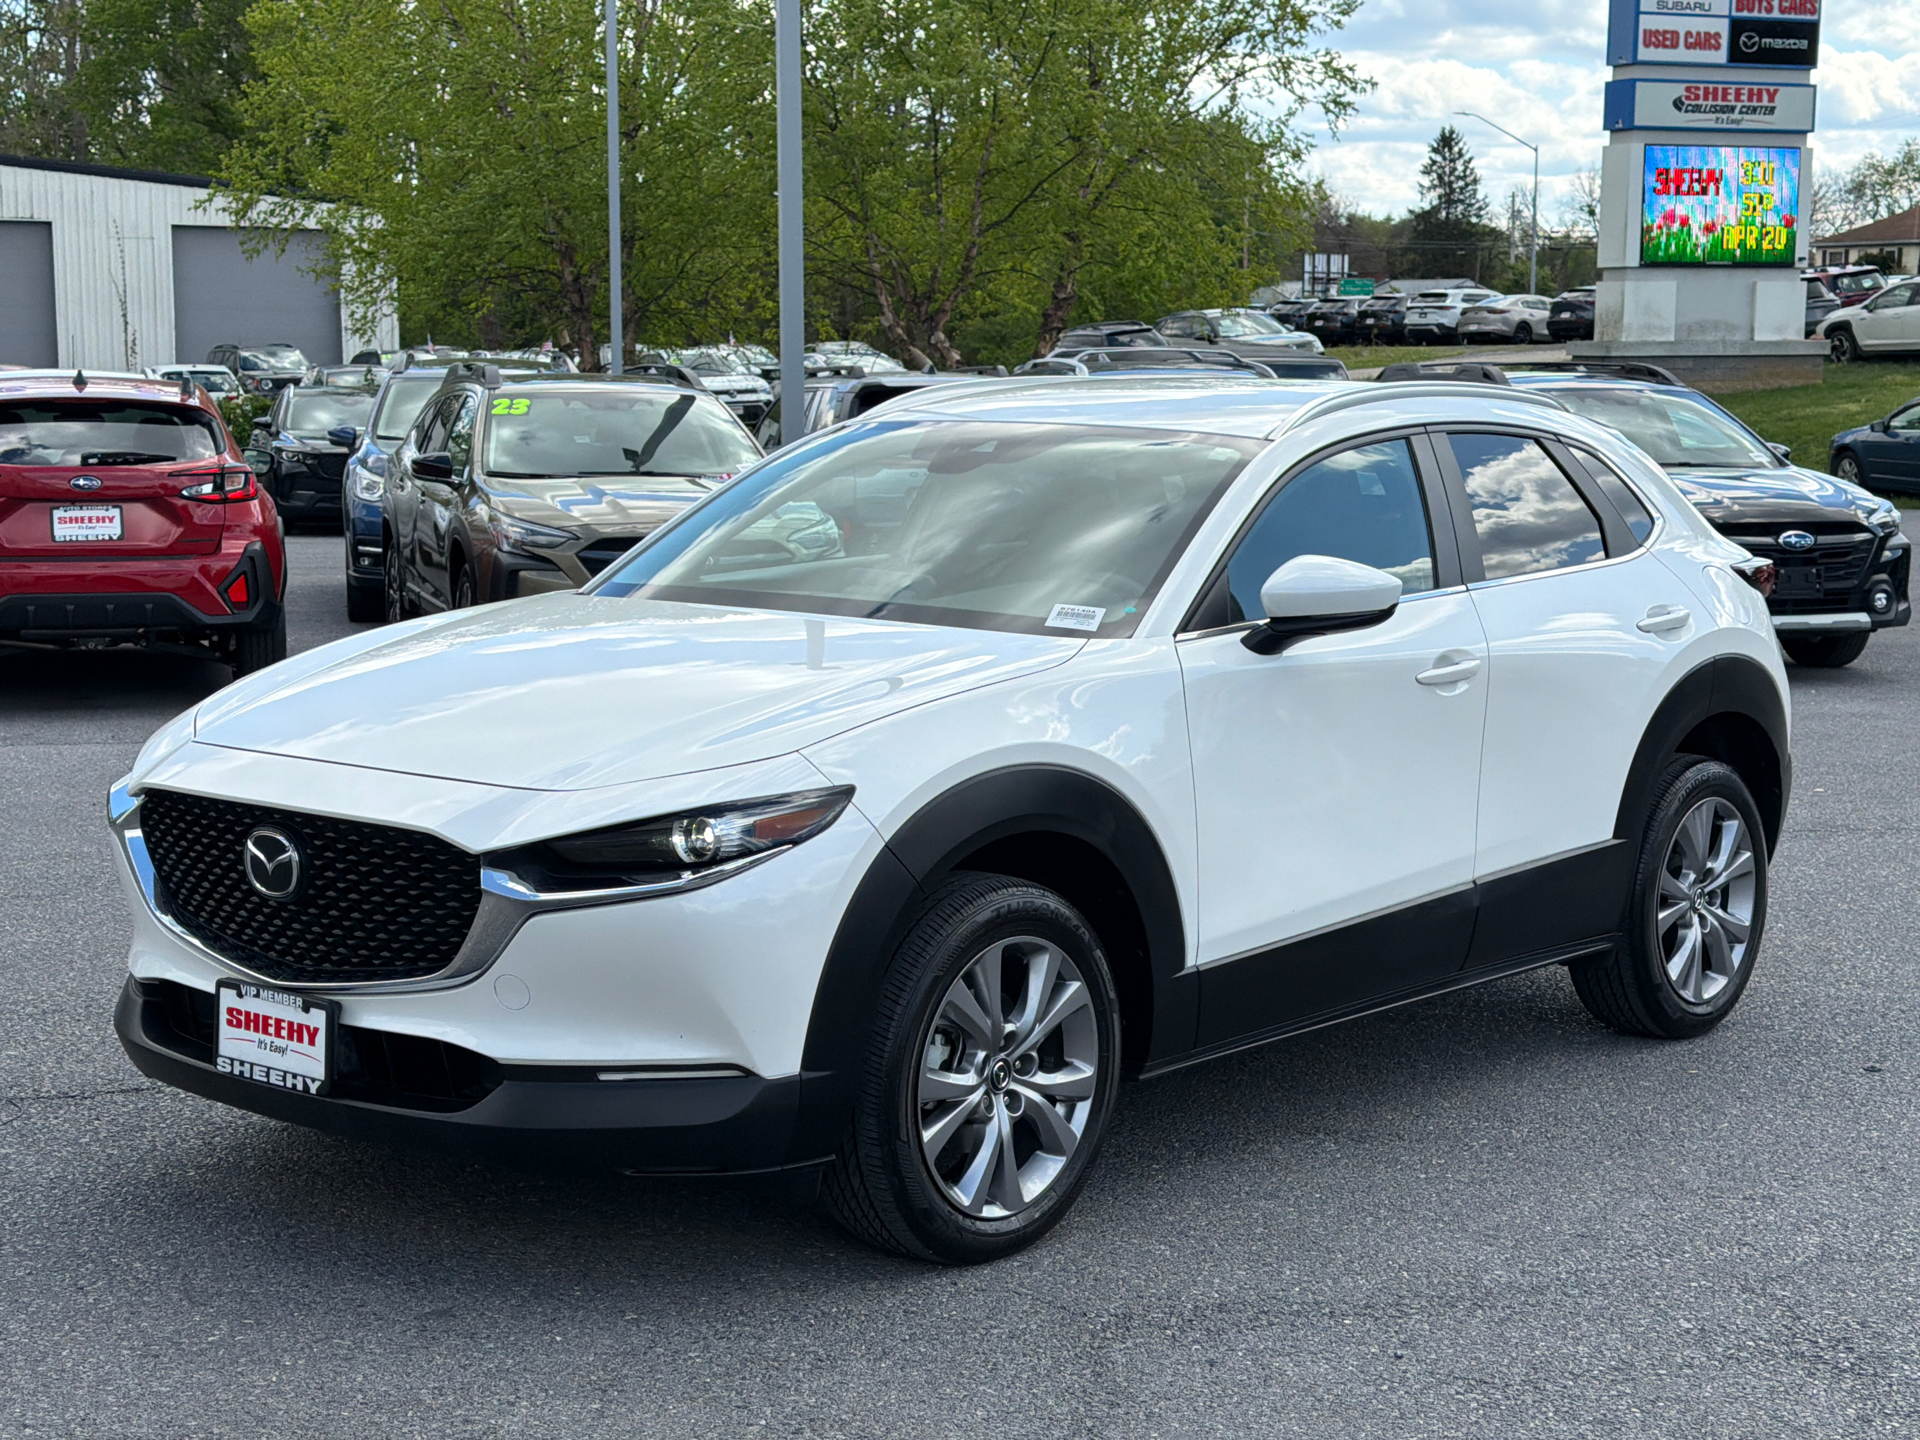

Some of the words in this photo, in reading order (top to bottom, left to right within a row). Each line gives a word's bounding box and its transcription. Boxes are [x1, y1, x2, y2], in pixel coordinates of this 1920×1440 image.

[1656, 0, 1712, 12] SUBARU
[1778, 0, 1818, 16] CARS
[1642, 28, 1679, 49] USED
[1684, 30, 1721, 51] CARS
[1761, 37, 1808, 50] mazda
[1684, 85, 1780, 104] SHEEHY
[1683, 103, 1737, 114] COLLISION
[1738, 104, 1777, 116] CENTER
[1654, 167, 1723, 197] SHEEHY
[1722, 225, 1758, 250] APR
[1762, 226, 1787, 250] 20
[491, 398, 531, 415] 23
[57, 516, 116, 525] SHEEHY
[240, 984, 257, 997] VIP
[260, 988, 303, 1008] MEMBER
[226, 1006, 320, 1047] SHEEHY
[256, 1037, 268, 1051] It's
[268, 1040, 289, 1058] Easy!
[216, 1056, 322, 1095] SHEEHY
